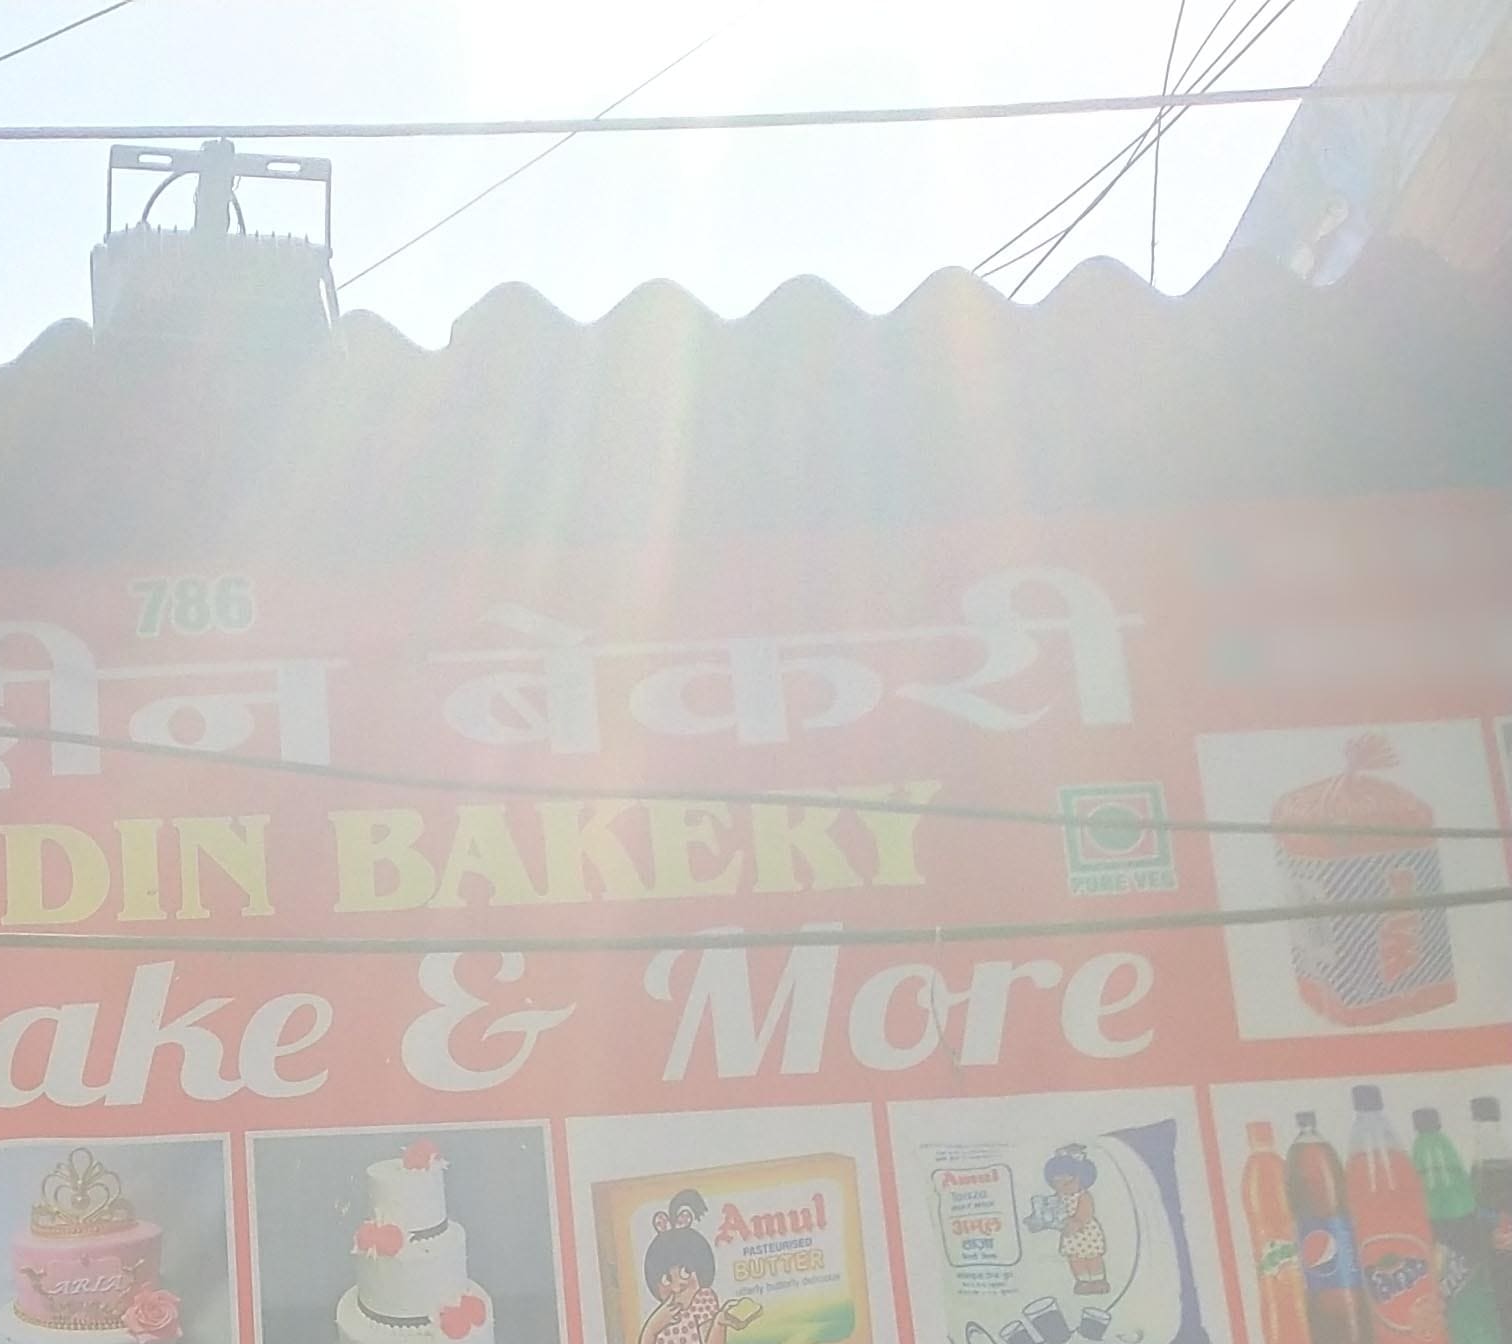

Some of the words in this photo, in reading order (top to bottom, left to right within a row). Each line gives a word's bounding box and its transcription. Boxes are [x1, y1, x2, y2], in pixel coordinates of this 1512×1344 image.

[130, 576, 255, 636] 786
[428, 568, 1145, 756] बेकरी
[330, 780, 943, 914] BAKERY
[401, 946, 576, 1092] &
[644, 923, 1154, 1083] More
[715, 1193, 827, 1247] Amul
[733, 1249, 824, 1281] BUTTER
